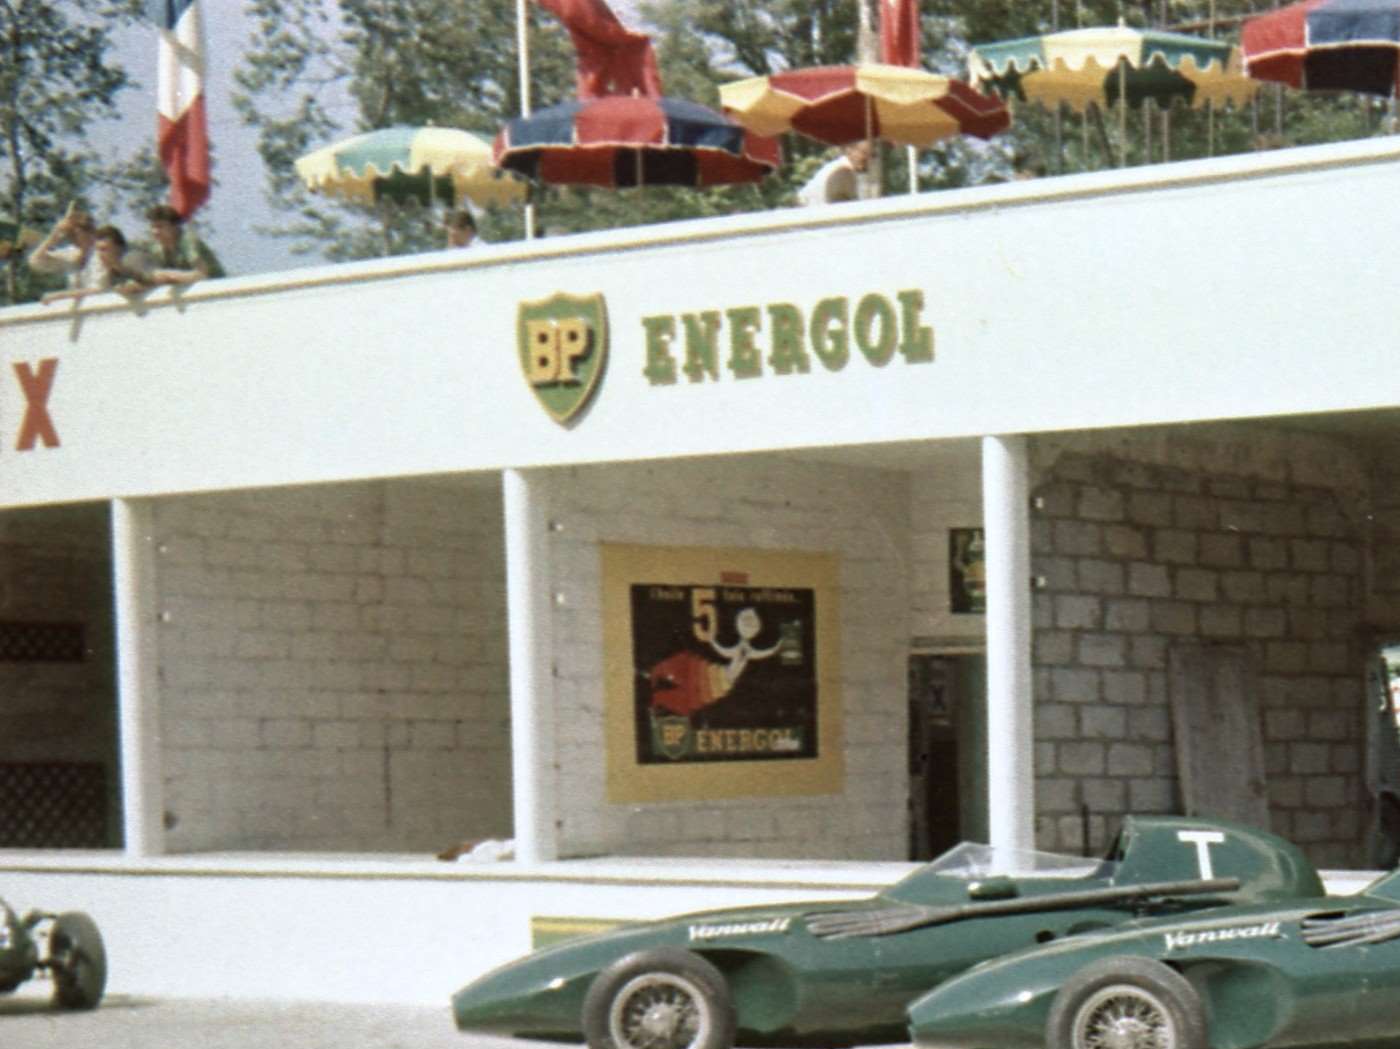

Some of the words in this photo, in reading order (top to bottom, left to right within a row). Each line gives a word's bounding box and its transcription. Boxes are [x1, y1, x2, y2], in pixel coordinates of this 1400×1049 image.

[527, 318, 592, 386] BP
[641, 289, 935, 387] ENERGOL
[692, 588, 718, 642] 5
[1177, 830, 1225, 881] T
[1164, 921, 1281, 951] Vanwall
